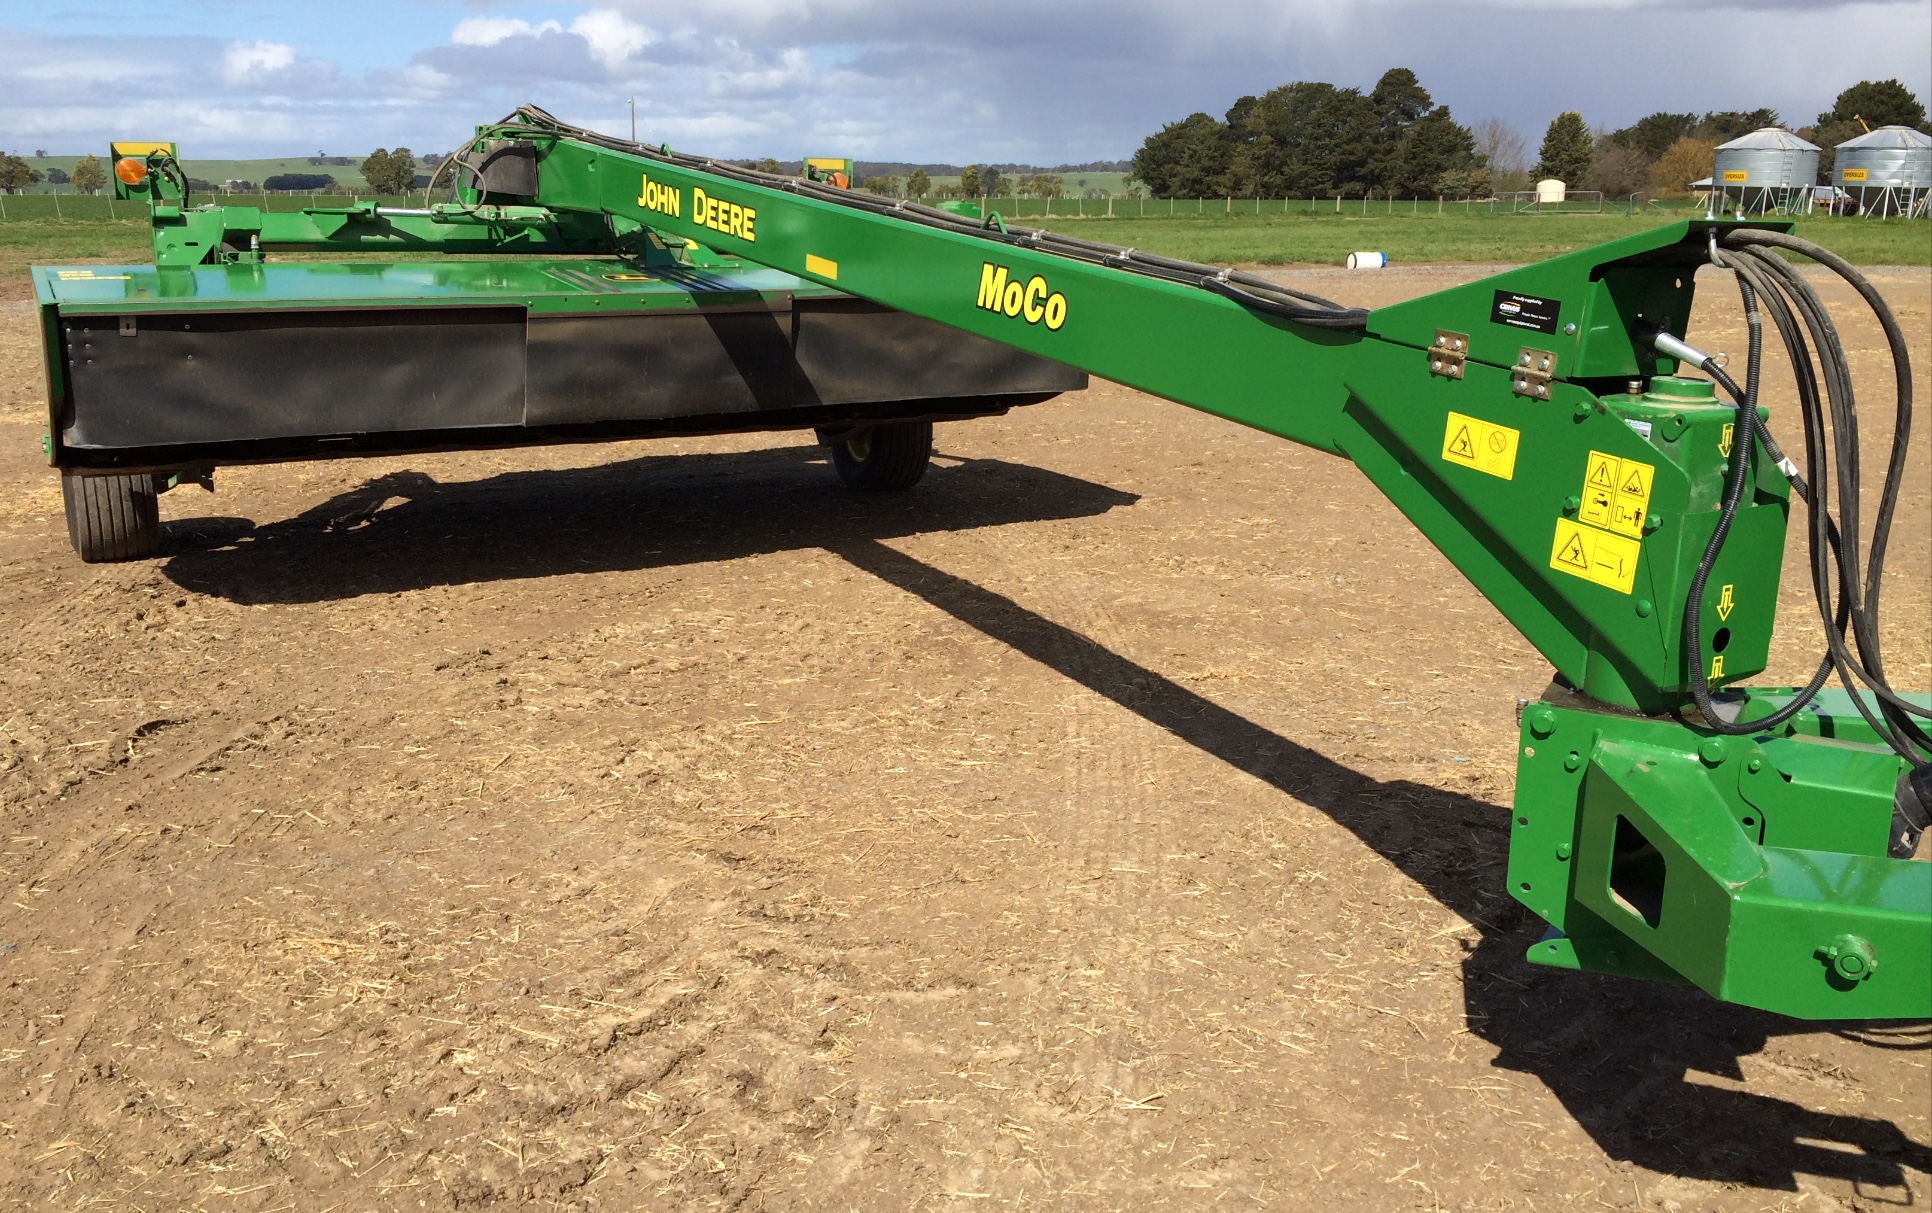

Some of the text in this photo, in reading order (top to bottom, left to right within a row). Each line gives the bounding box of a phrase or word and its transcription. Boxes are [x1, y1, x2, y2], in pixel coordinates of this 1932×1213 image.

[637, 172, 756, 243] JOHN DEERE
[976, 261, 1067, 332] MoCo
